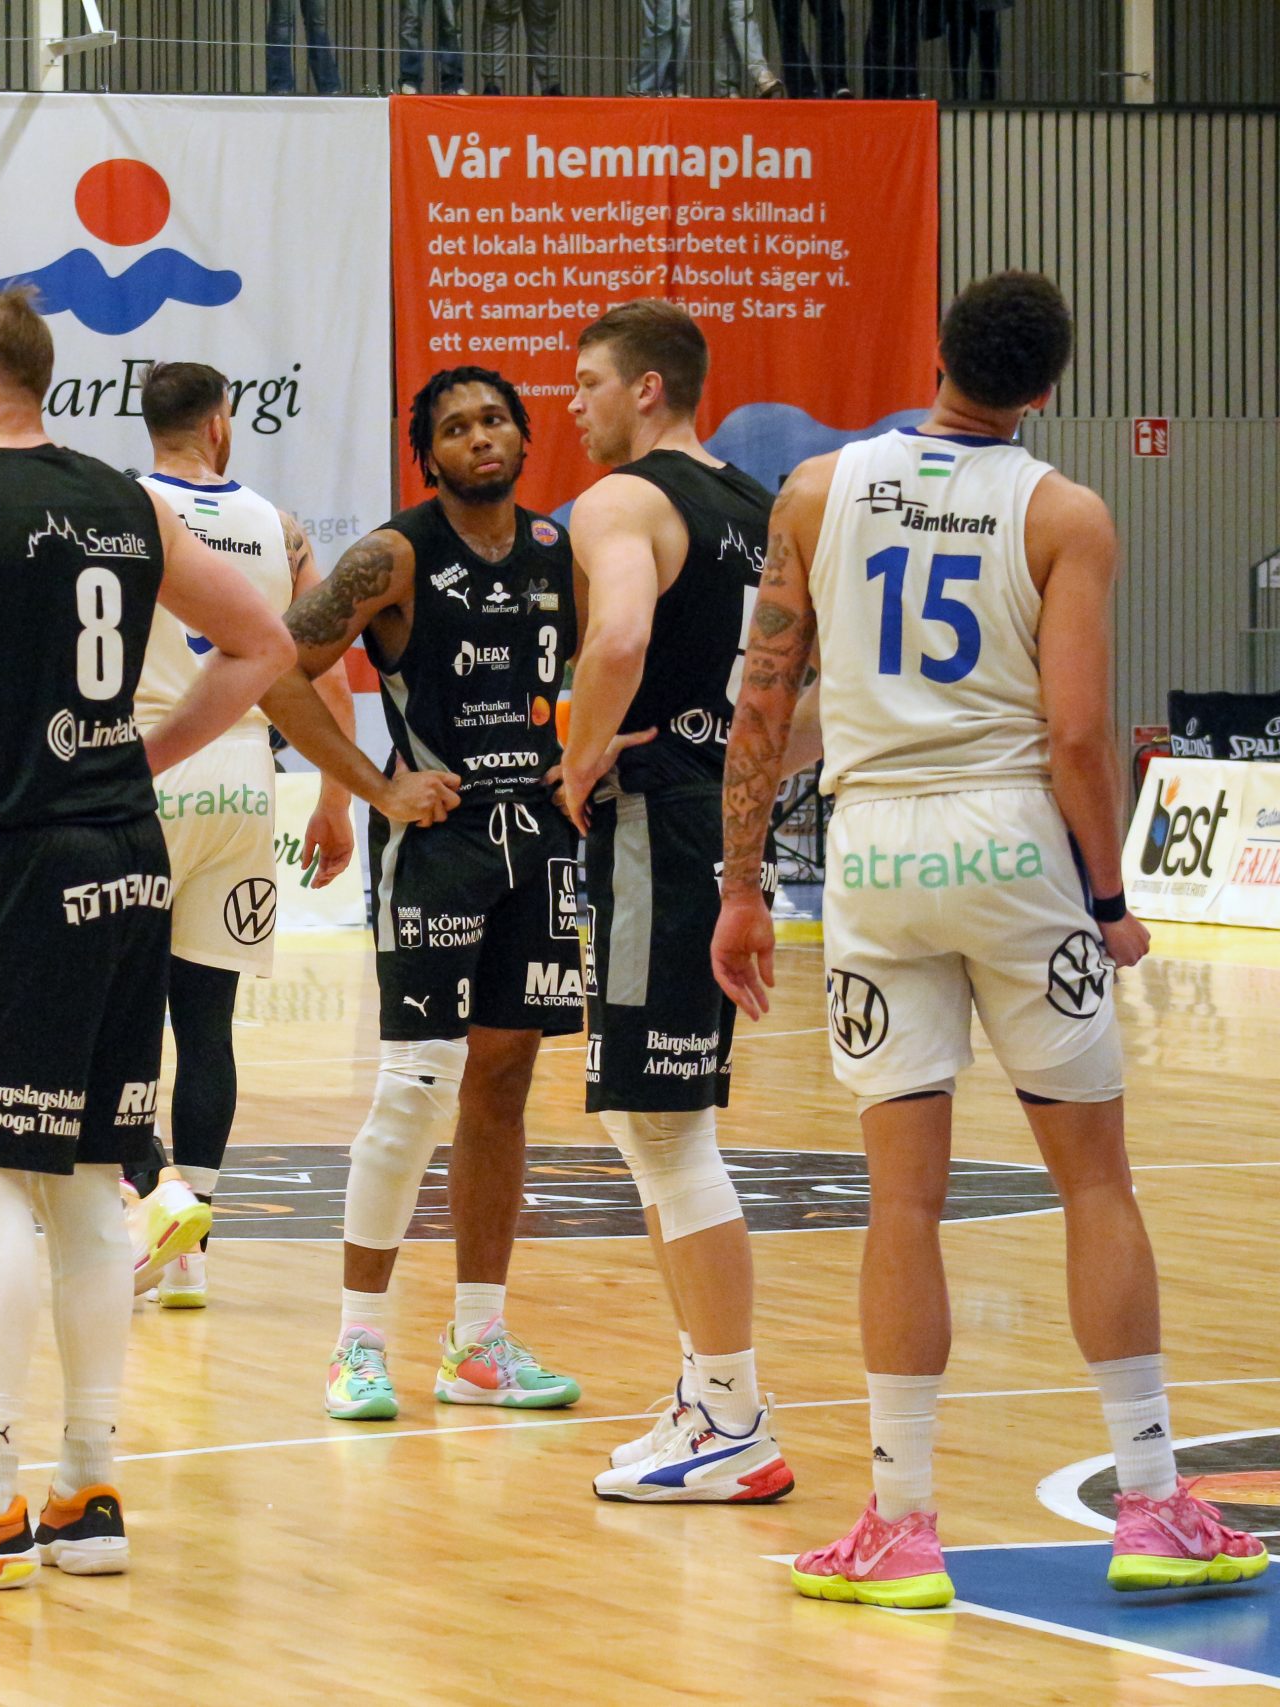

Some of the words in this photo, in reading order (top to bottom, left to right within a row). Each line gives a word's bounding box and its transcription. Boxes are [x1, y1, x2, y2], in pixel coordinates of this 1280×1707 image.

[427, 132, 512, 179] Vår
[526, 134, 813, 190] hemmaplan
[428, 202, 470, 223] Kan
[477, 207, 504, 223] en
[511, 202, 565, 223] bank
[571, 201, 671, 227] verkligen
[676, 201, 726, 226] göra
[732, 202, 814, 223] skillnad
[820, 202, 827, 223] i
[428, 234, 467, 256] det
[473, 234, 537, 256] lokala
[543, 232, 748, 255] hållbarhetsarbetet
[753, 233, 760, 254] i
[765, 233, 850, 260] Köping,
[428, 266, 508, 293] Arboga
[514, 266, 556, 288] och
[563, 264, 669, 291] Kungsör?
[671, 264, 754, 286] Absolut
[760, 265, 821, 292] säger
[826, 265, 851, 287] vi.
[428, 298, 474, 320] Vårt
[481, 299, 600, 320] samarbete
[666, 297, 736, 323] öping
[741, 298, 798, 319] Stars
[803, 298, 827, 319] är
[429, 332, 462, 352] ett
[468, 330, 571, 357] exempel.
[901, 507, 997, 536] Jämtkraft
[86, 528, 147, 555] Senäte
[866, 545, 982, 684] 15
[75, 566, 124, 701] 8
[476, 646, 510, 663] LEAX
[538, 625, 558, 683] 3
[1229, 734, 1280, 760] SPAL
[463, 751, 539, 772] VOLVO
[158, 783, 268, 821] trakta
[842, 838, 1044, 890] atrakta
[558, 915, 578, 931] YA
[525, 961, 584, 996] MA
[457, 977, 470, 1019] 3
[524, 995, 542, 1006] ICA
[543, 996, 585, 1007] STORMA
[643, 1056, 699, 1080] Arboga
[114, 1114, 143, 1126] BÄST
